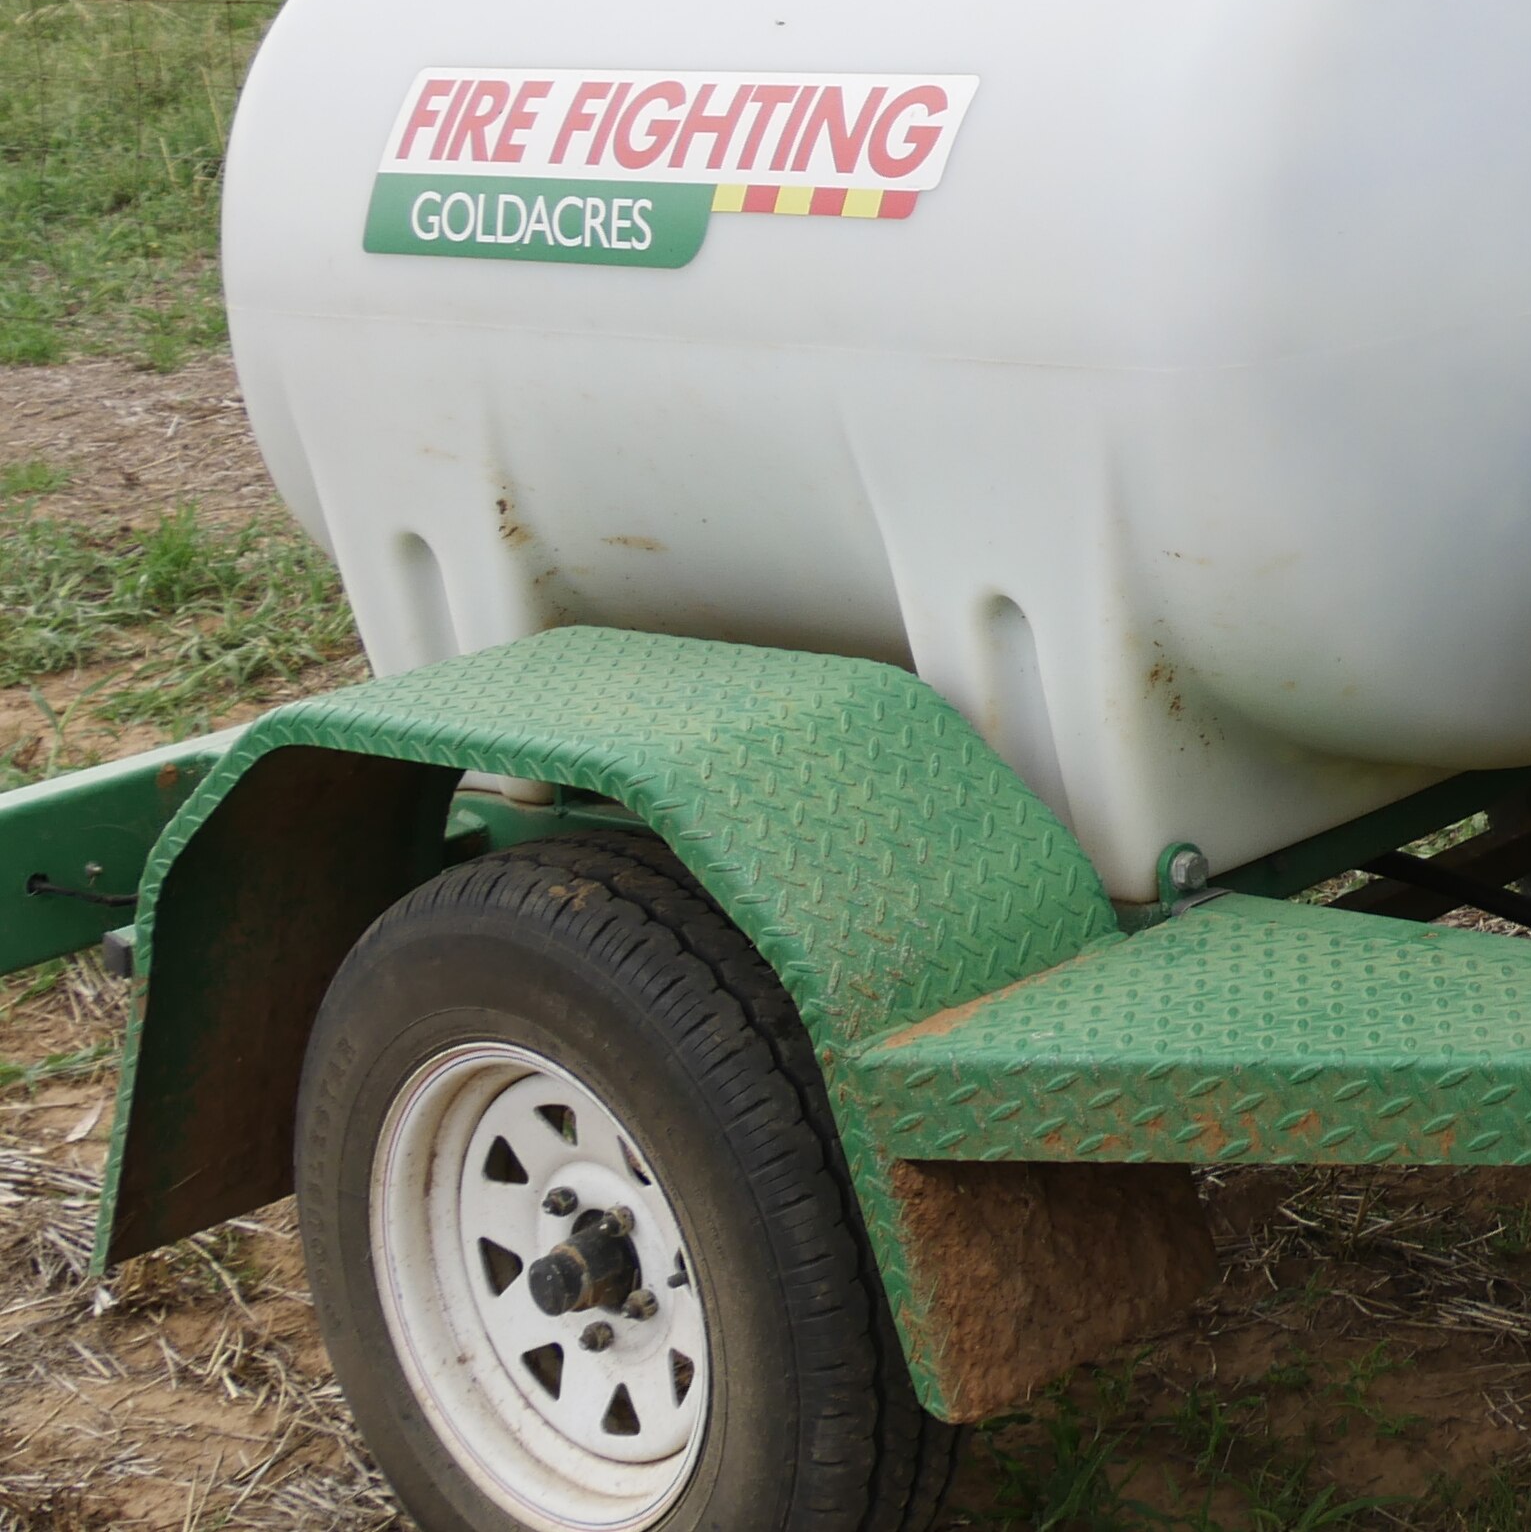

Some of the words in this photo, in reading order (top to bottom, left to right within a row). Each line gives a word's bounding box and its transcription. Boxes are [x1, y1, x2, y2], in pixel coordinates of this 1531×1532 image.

[395, 79, 555, 163] FIRE
[549, 80, 948, 178] FIGHTING
[411, 191, 653, 251] GOLDACRES
